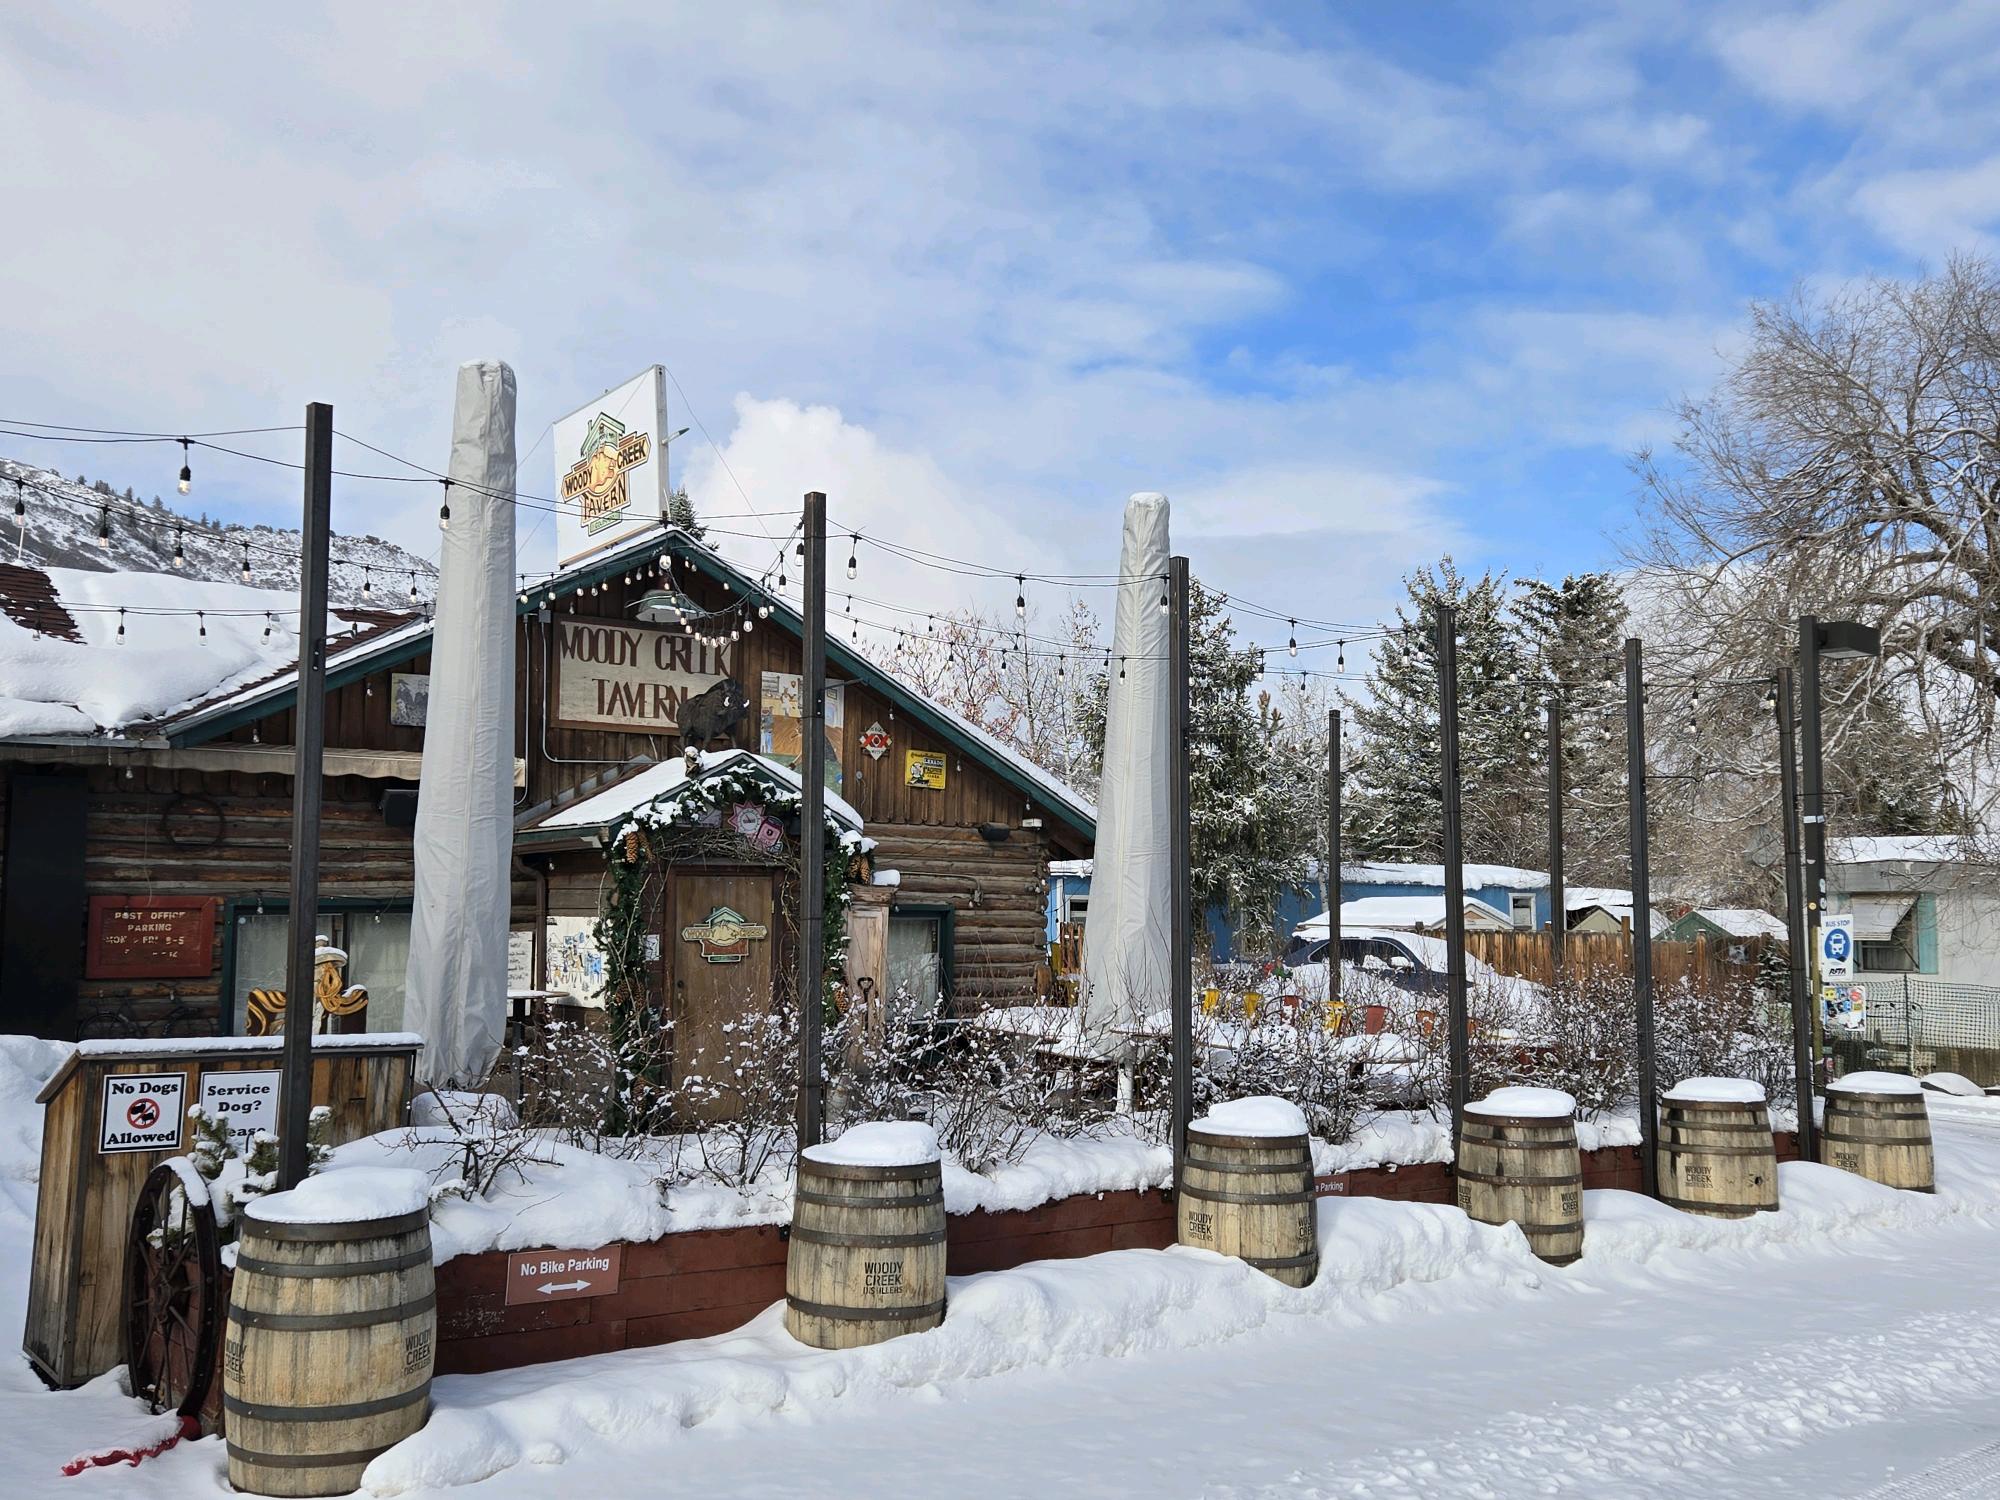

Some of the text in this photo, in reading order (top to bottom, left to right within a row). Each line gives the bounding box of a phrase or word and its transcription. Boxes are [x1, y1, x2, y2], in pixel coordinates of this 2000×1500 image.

[565, 439, 646, 496] WOODY CREEK
[583, 477, 627, 521] TAVERN
[560, 624, 732, 677] WOODY CREEK
[591, 678, 689, 724] TAVERN
[127, 923, 172, 932] PARKING
[1837, 919, 1850, 927] STOP
[111, 1082, 179, 1096] No Dogs
[207, 1084, 271, 1097] Service
[218, 1100, 262, 1114] Dog?
[106, 1130, 176, 1145] Allowed
[229, 1127, 266, 1137] eas
[1686, 1174, 1712, 1183] CREEK
[1320, 1181, 1344, 1192] Parking
[1189, 1210, 1213, 1224] WOODY
[1189, 1221, 1212, 1235] CREEK
[520, 1256, 610, 1276] No Bike Parking
[865, 1261, 904, 1274] WOODY
[865, 1274, 902, 1286] CREEK
